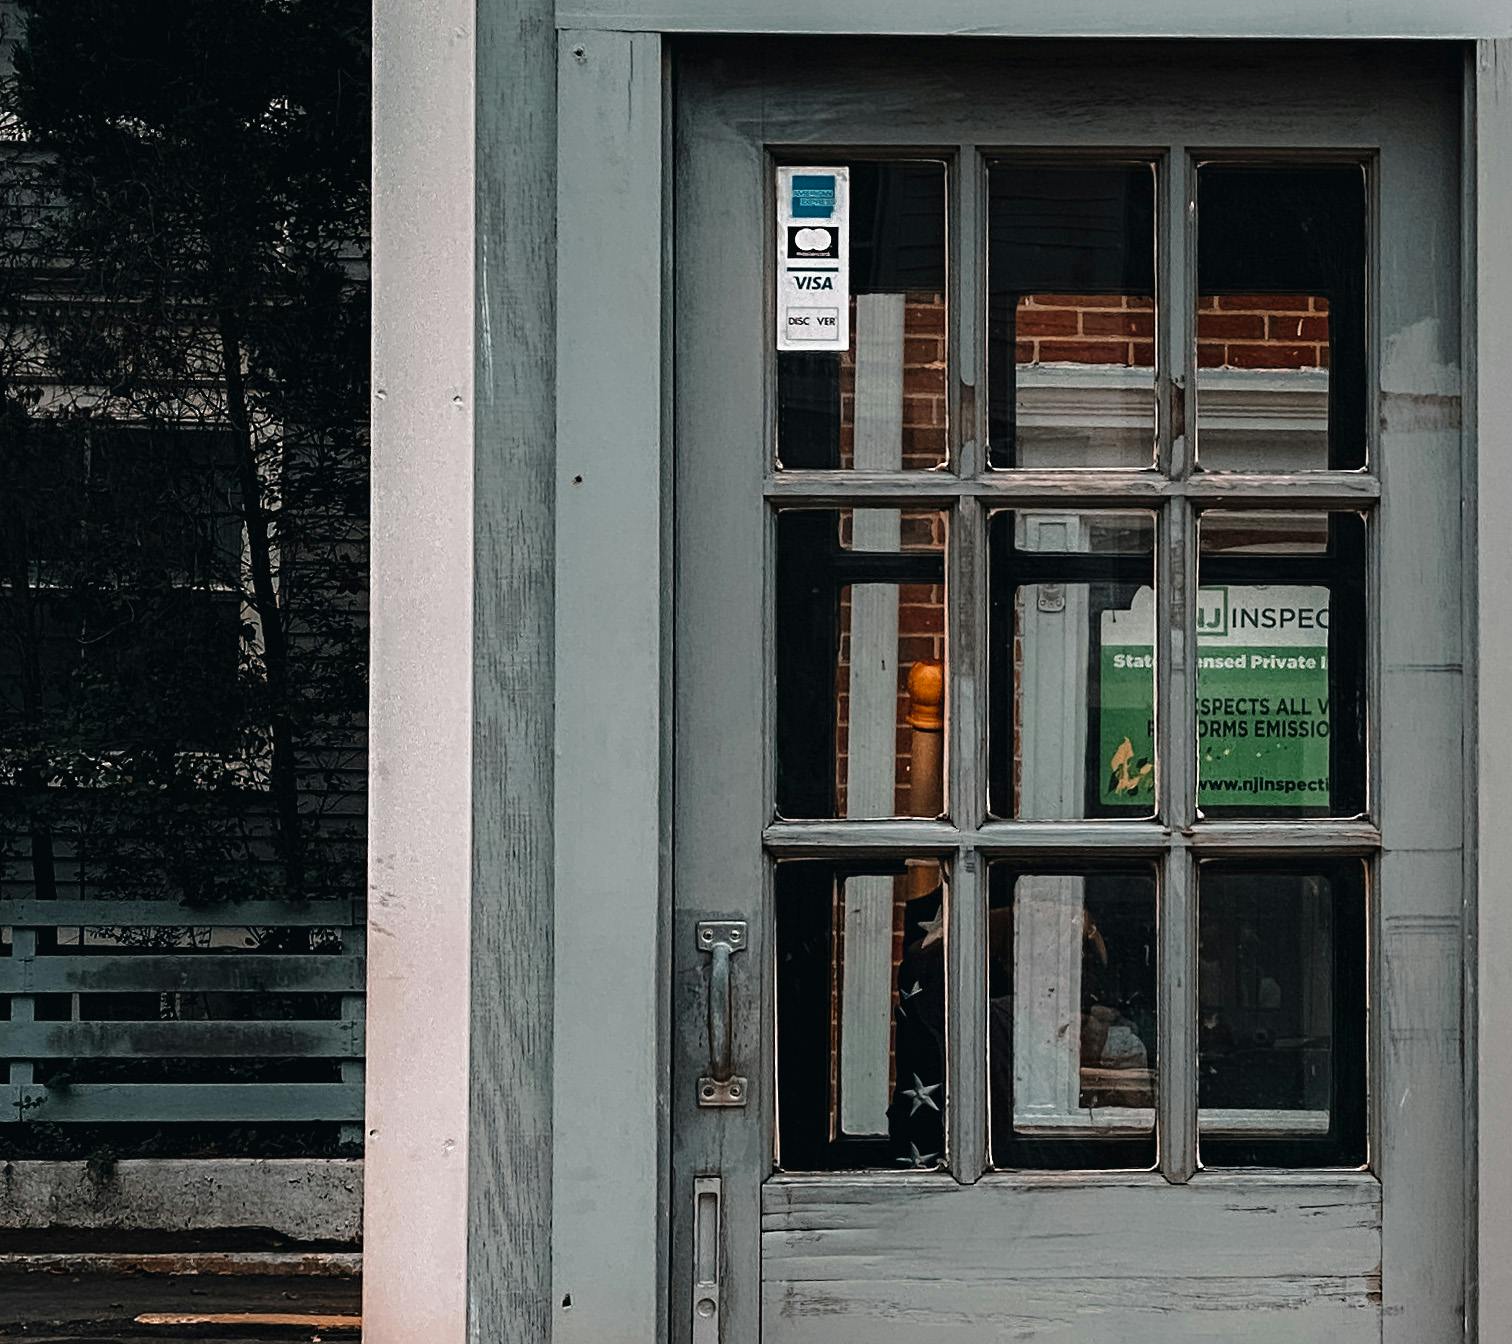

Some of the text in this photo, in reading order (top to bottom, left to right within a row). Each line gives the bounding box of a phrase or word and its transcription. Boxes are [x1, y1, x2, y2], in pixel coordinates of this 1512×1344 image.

[794, 276, 833, 290] VISA
[1250, 655, 1316, 669] Private
[1196, 698, 1270, 716] SPECTS
[1275, 698, 1312, 716] ALL
[1254, 720, 1329, 738] EMISSIO
